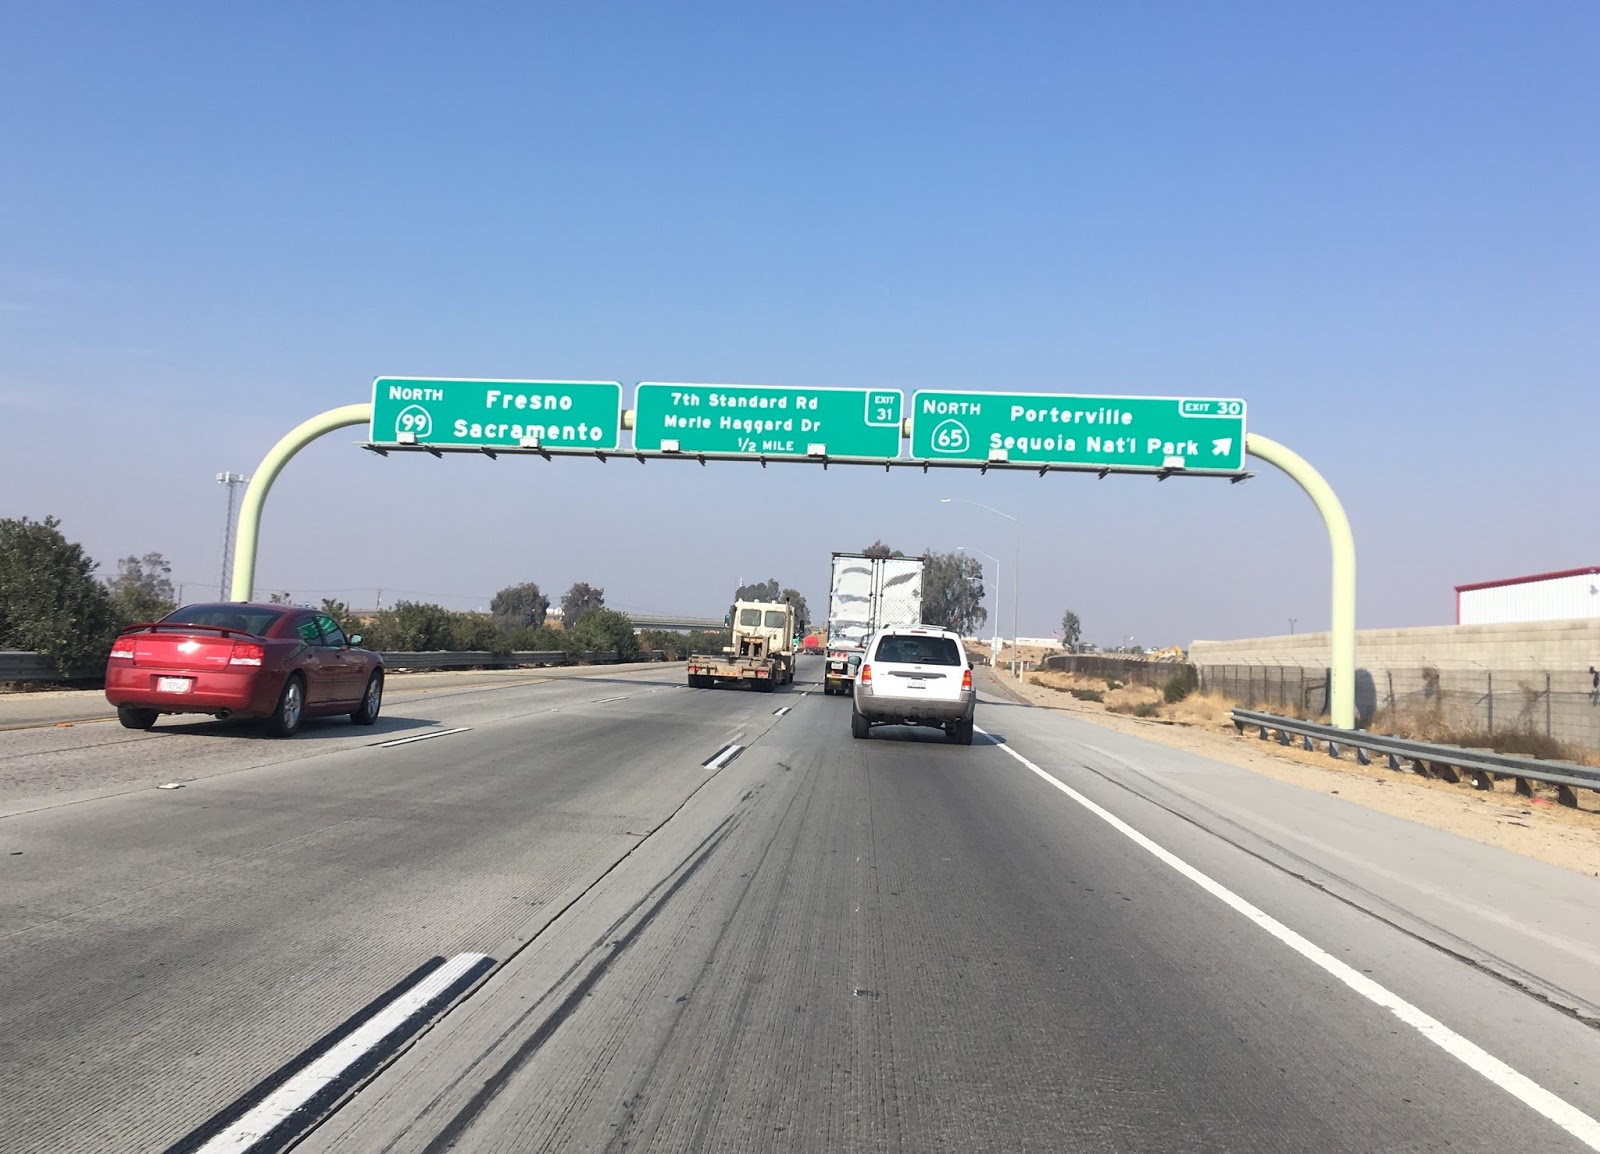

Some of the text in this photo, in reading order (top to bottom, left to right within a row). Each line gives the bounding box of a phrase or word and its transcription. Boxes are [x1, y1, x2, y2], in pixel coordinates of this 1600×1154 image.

[389, 385, 443, 401] NORTH
[486, 390, 573, 411] Fresno
[671, 392, 818, 410] 7th Standard Rd
[874, 395, 895, 404] EXIT
[876, 408, 892, 421] 31
[923, 399, 981, 415] NORTH
[1010, 405, 1133, 425] Porterville
[1184, 402, 1240, 415] EXIT 30
[402, 413, 427, 432] 99
[453, 419, 603, 441] Sacramento
[664, 414, 821, 434] Merle Haggard Dr
[763, 440, 794, 451] MILE
[937, 429, 963, 447] 65
[989, 432, 1199, 456] Sequoia Nat'l Park
